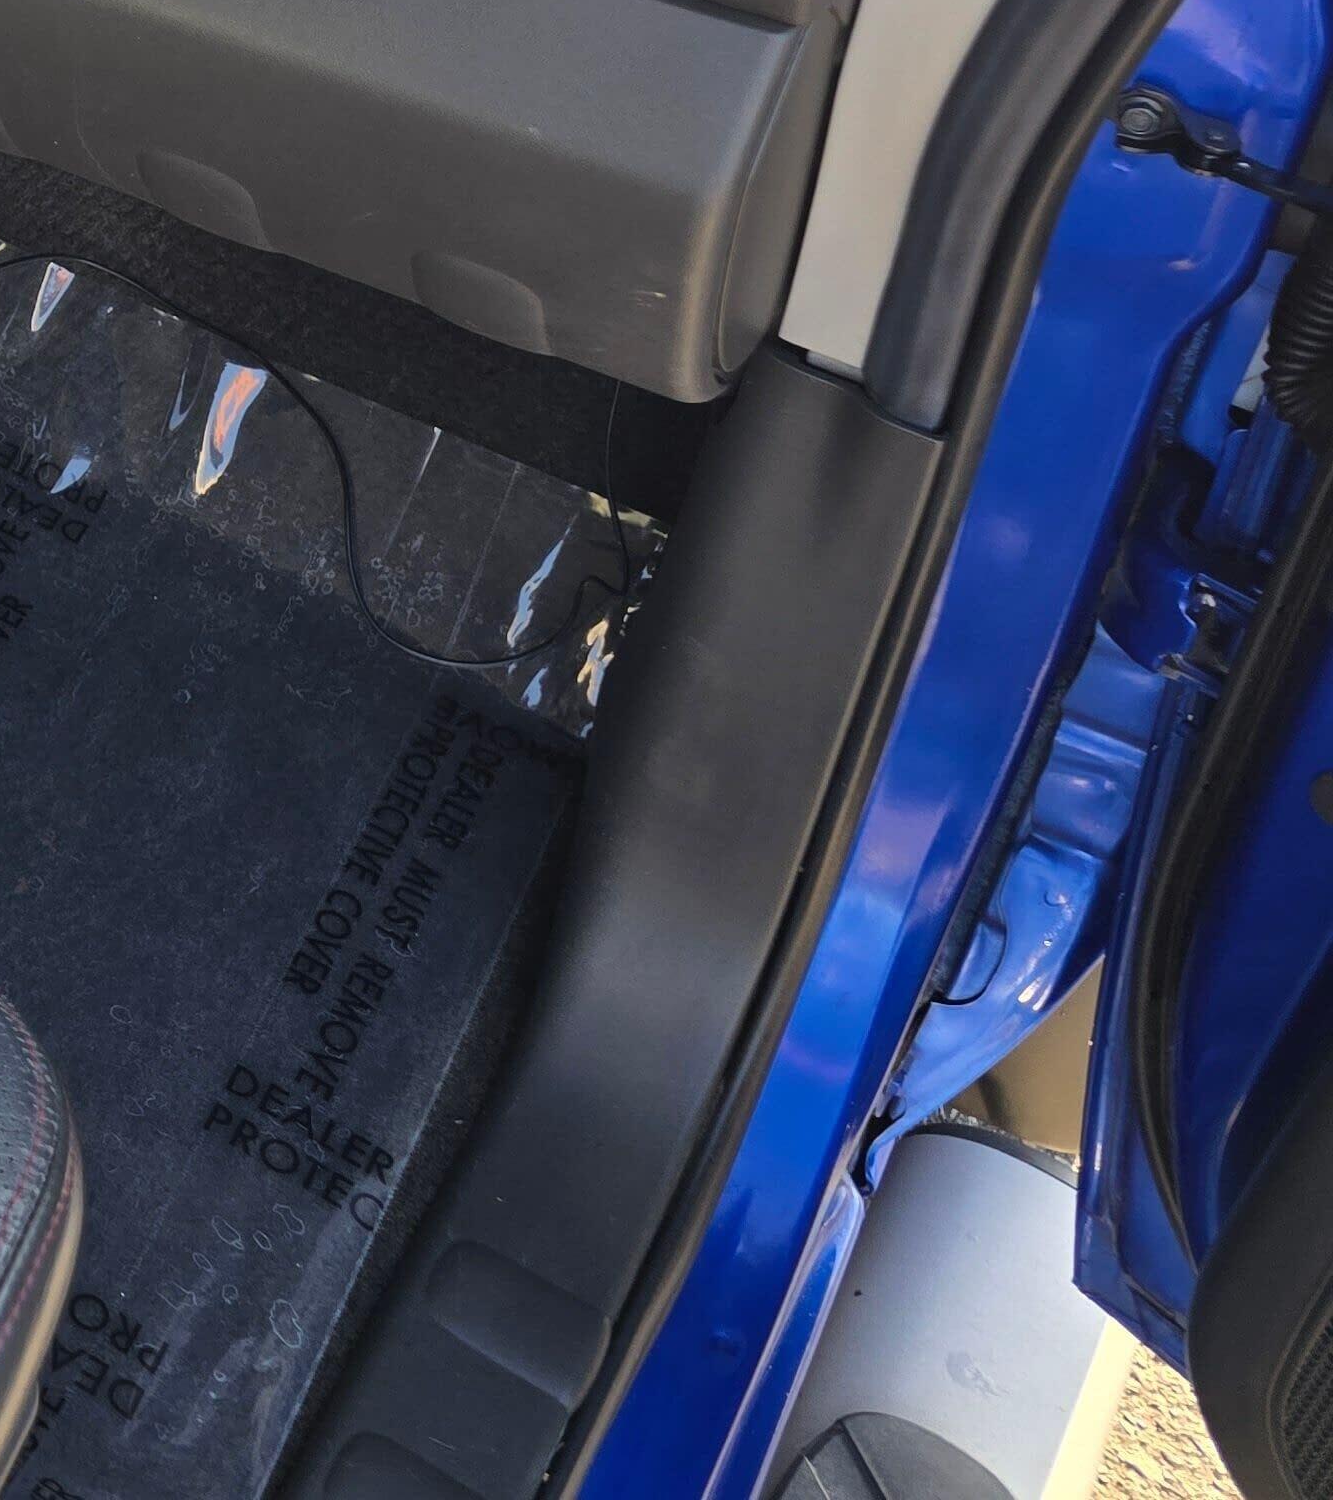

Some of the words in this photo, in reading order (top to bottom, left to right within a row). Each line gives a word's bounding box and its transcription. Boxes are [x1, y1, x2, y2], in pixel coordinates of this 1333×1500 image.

[281, 891, 365, 1000] COVER
[379, 855, 445, 954] MUST
[294, 949, 395, 1106] REMOVE
[201, 1101, 387, 1234] PROTEC
[224, 1061, 396, 1187] DEALER
